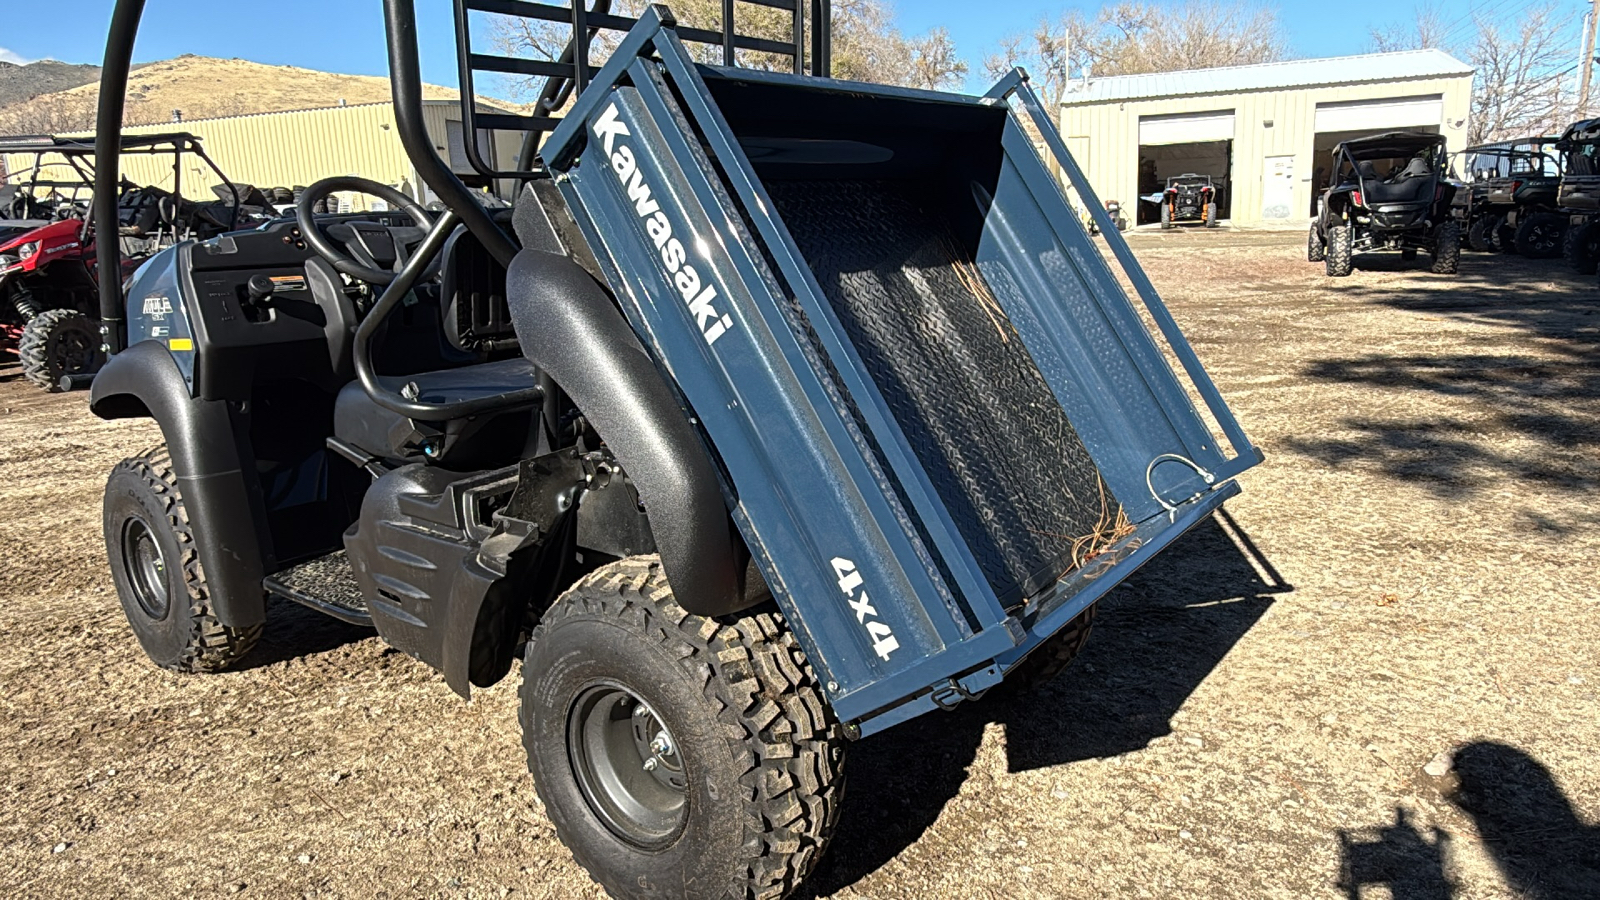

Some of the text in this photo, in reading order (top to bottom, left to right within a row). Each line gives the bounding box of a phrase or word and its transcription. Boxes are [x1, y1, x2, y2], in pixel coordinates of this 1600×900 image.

[593, 102, 734, 346] Kawasaki
[142, 297, 174, 314] MULE
[152, 313, 165, 321] SX
[830, 556, 900, 662] 4x4
